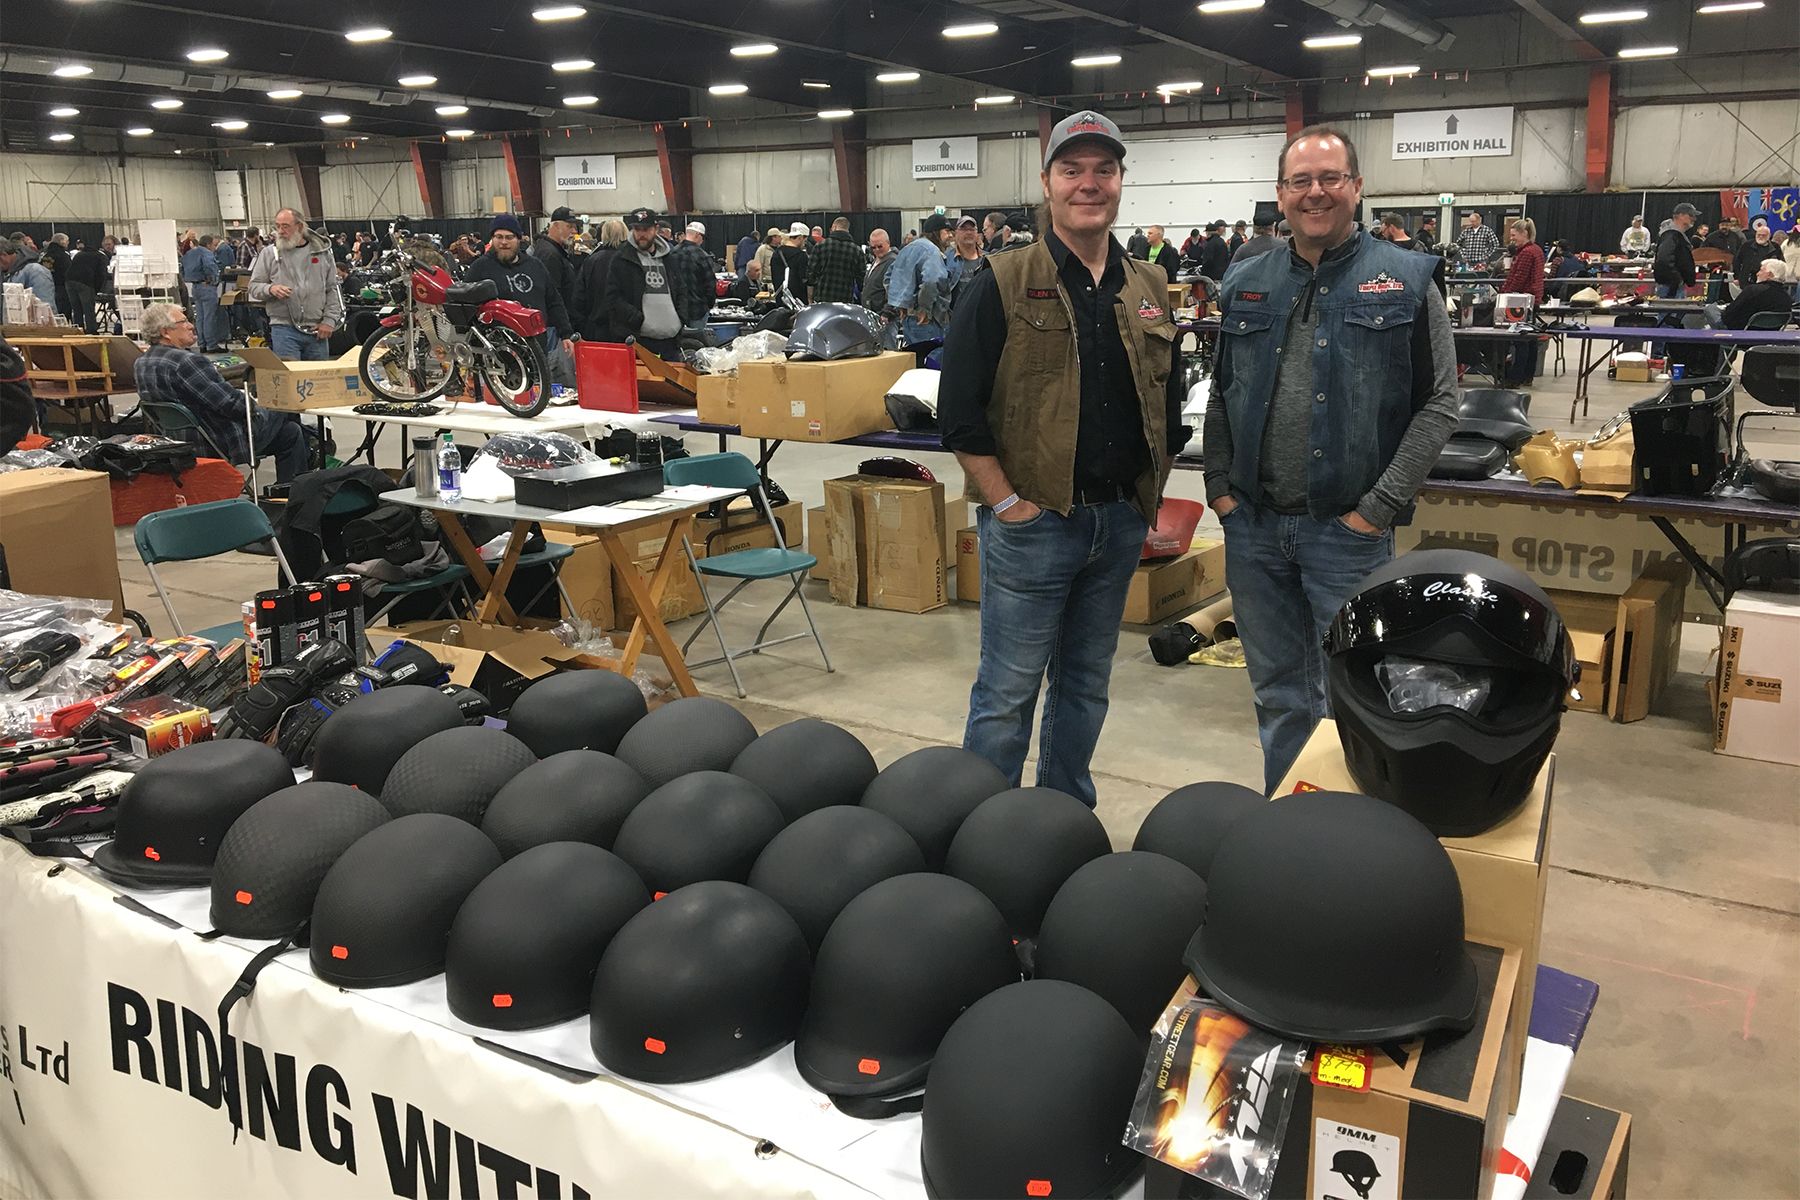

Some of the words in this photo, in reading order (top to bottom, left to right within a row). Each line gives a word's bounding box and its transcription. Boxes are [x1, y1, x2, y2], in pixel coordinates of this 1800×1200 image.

[1396, 140, 1470, 153] EXHIBITION
[1473, 138, 1507, 150] HALL
[915, 164, 955, 172] EXHIBITION
[956, 163, 975, 171] HALL
[1242, 293, 1263, 301] TROY
[1423, 581, 1499, 602] Clasic
[1722, 660, 1733, 693] SUZUKI
[107, 981, 358, 1176] RIDING
[1336, 1126, 1377, 1143] 9MM
